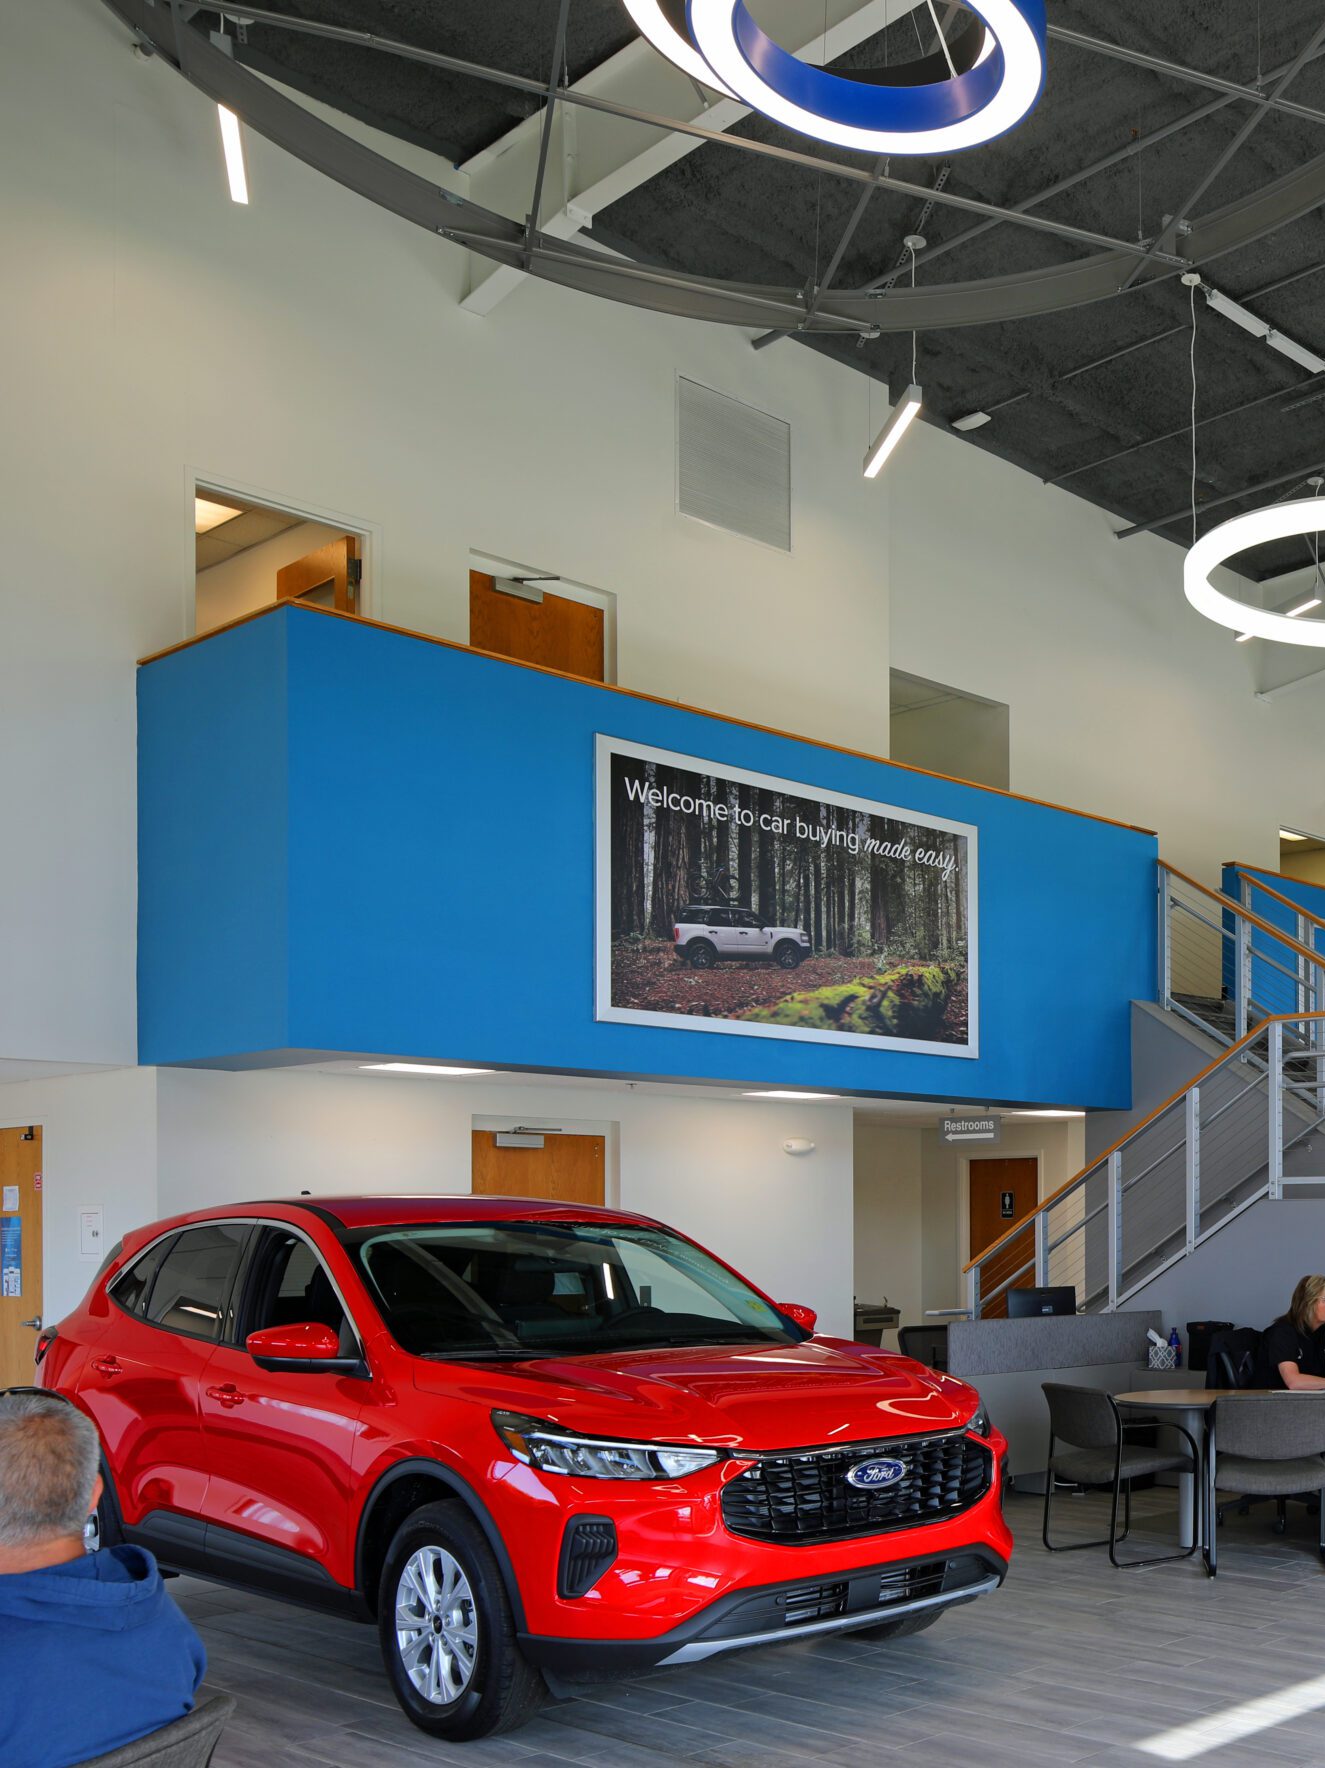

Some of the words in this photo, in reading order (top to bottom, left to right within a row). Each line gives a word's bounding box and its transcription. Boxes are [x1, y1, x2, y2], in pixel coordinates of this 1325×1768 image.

[624, 776, 729, 822] Welcome
[735, 803, 755, 827] to
[759, 814, 790, 835] car
[796, 817, 860, 853] buying
[864, 836, 912, 861] made
[915, 847, 960, 881] easy.
[944, 1120, 995, 1132] Restrooms
[863, 1464, 895, 1482] Ford
